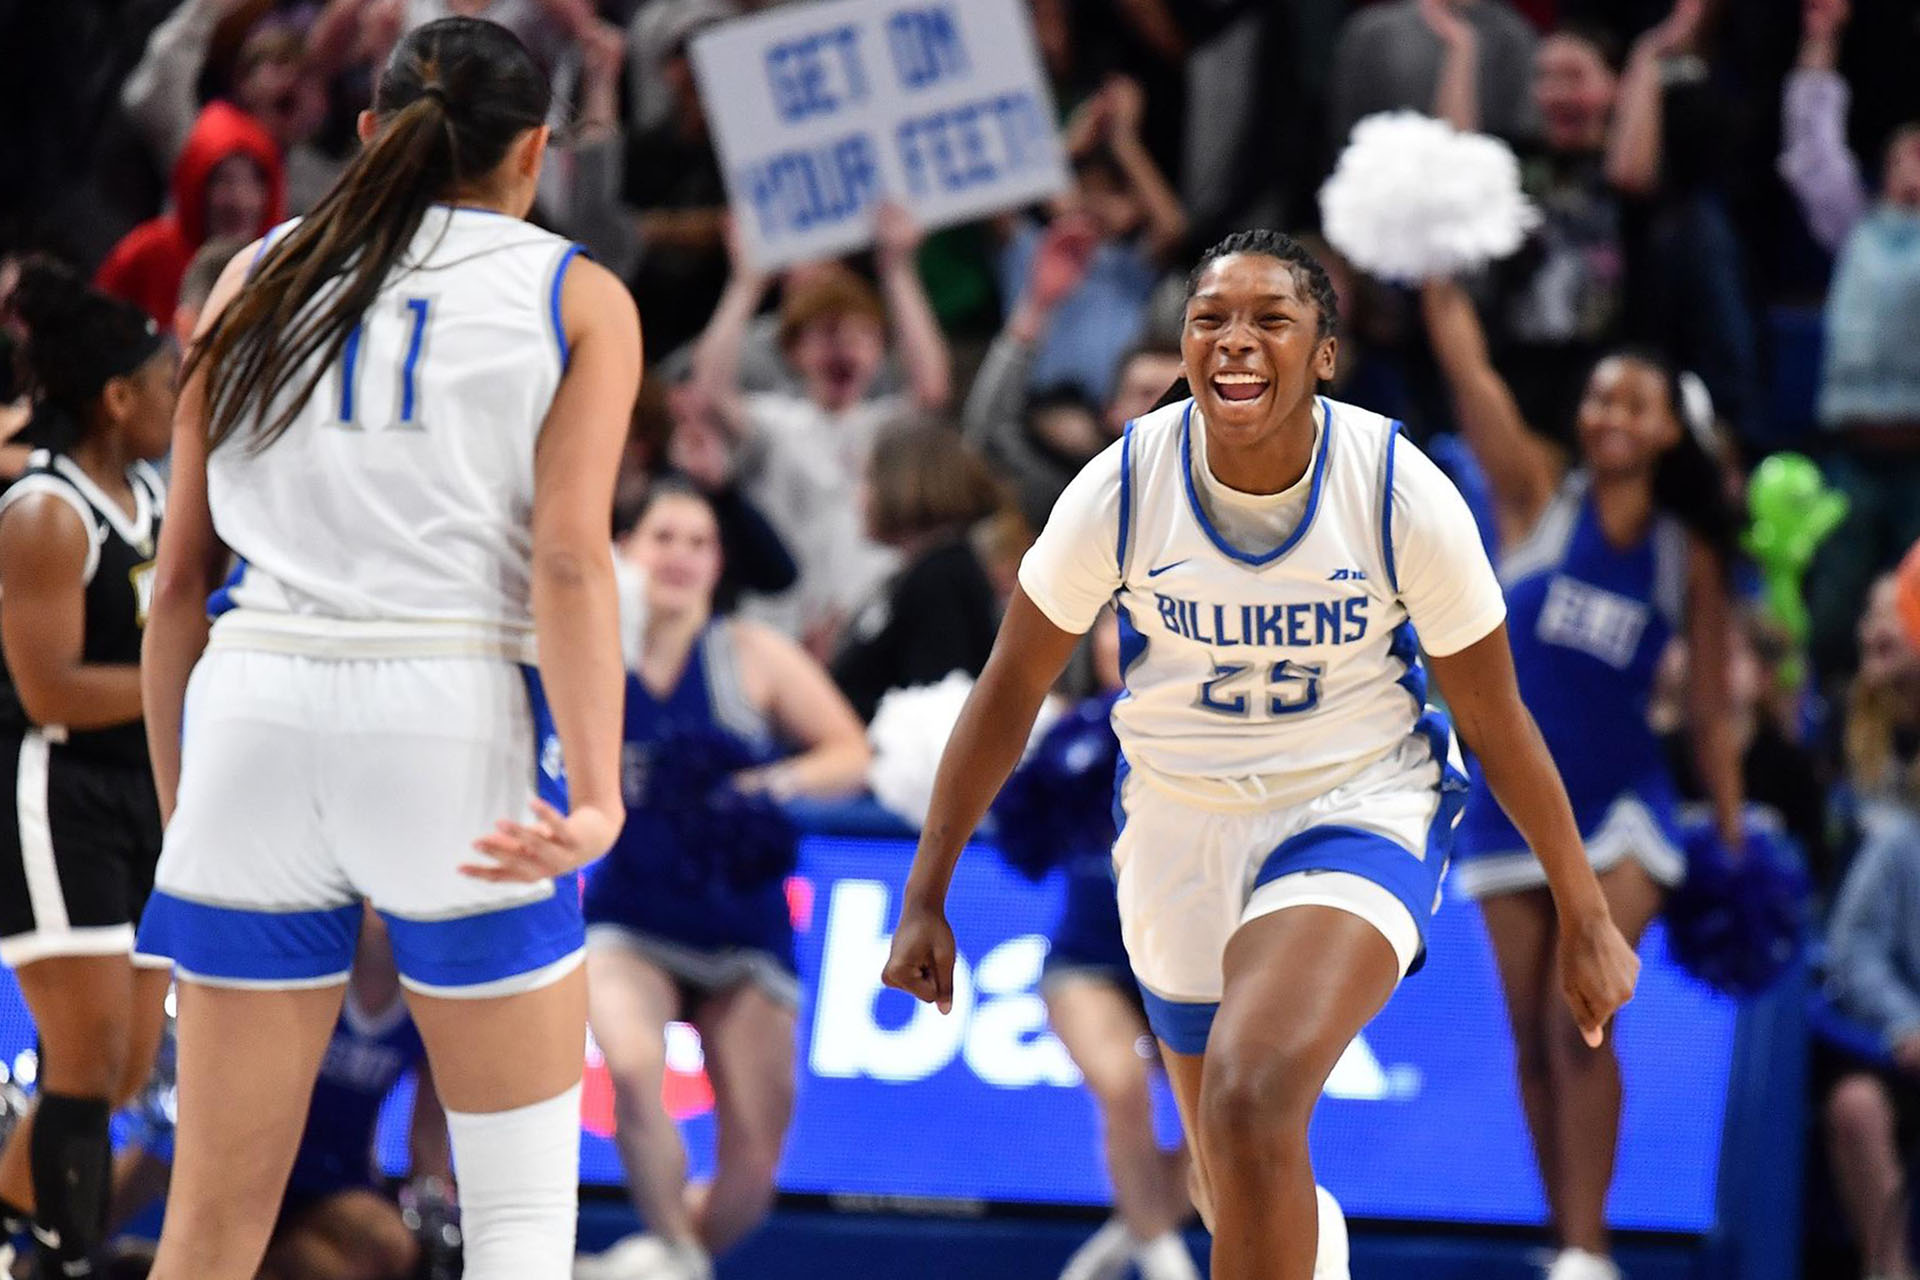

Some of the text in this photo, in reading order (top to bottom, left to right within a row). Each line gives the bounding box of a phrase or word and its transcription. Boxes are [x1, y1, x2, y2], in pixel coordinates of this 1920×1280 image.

[766, 6, 970, 122] GET ON
[740, 134, 878, 242] YOUR
[320, 293, 441, 430] 11
[1155, 593, 1368, 647] BILLIKENS
[1194, 660, 1326, 716] 25
